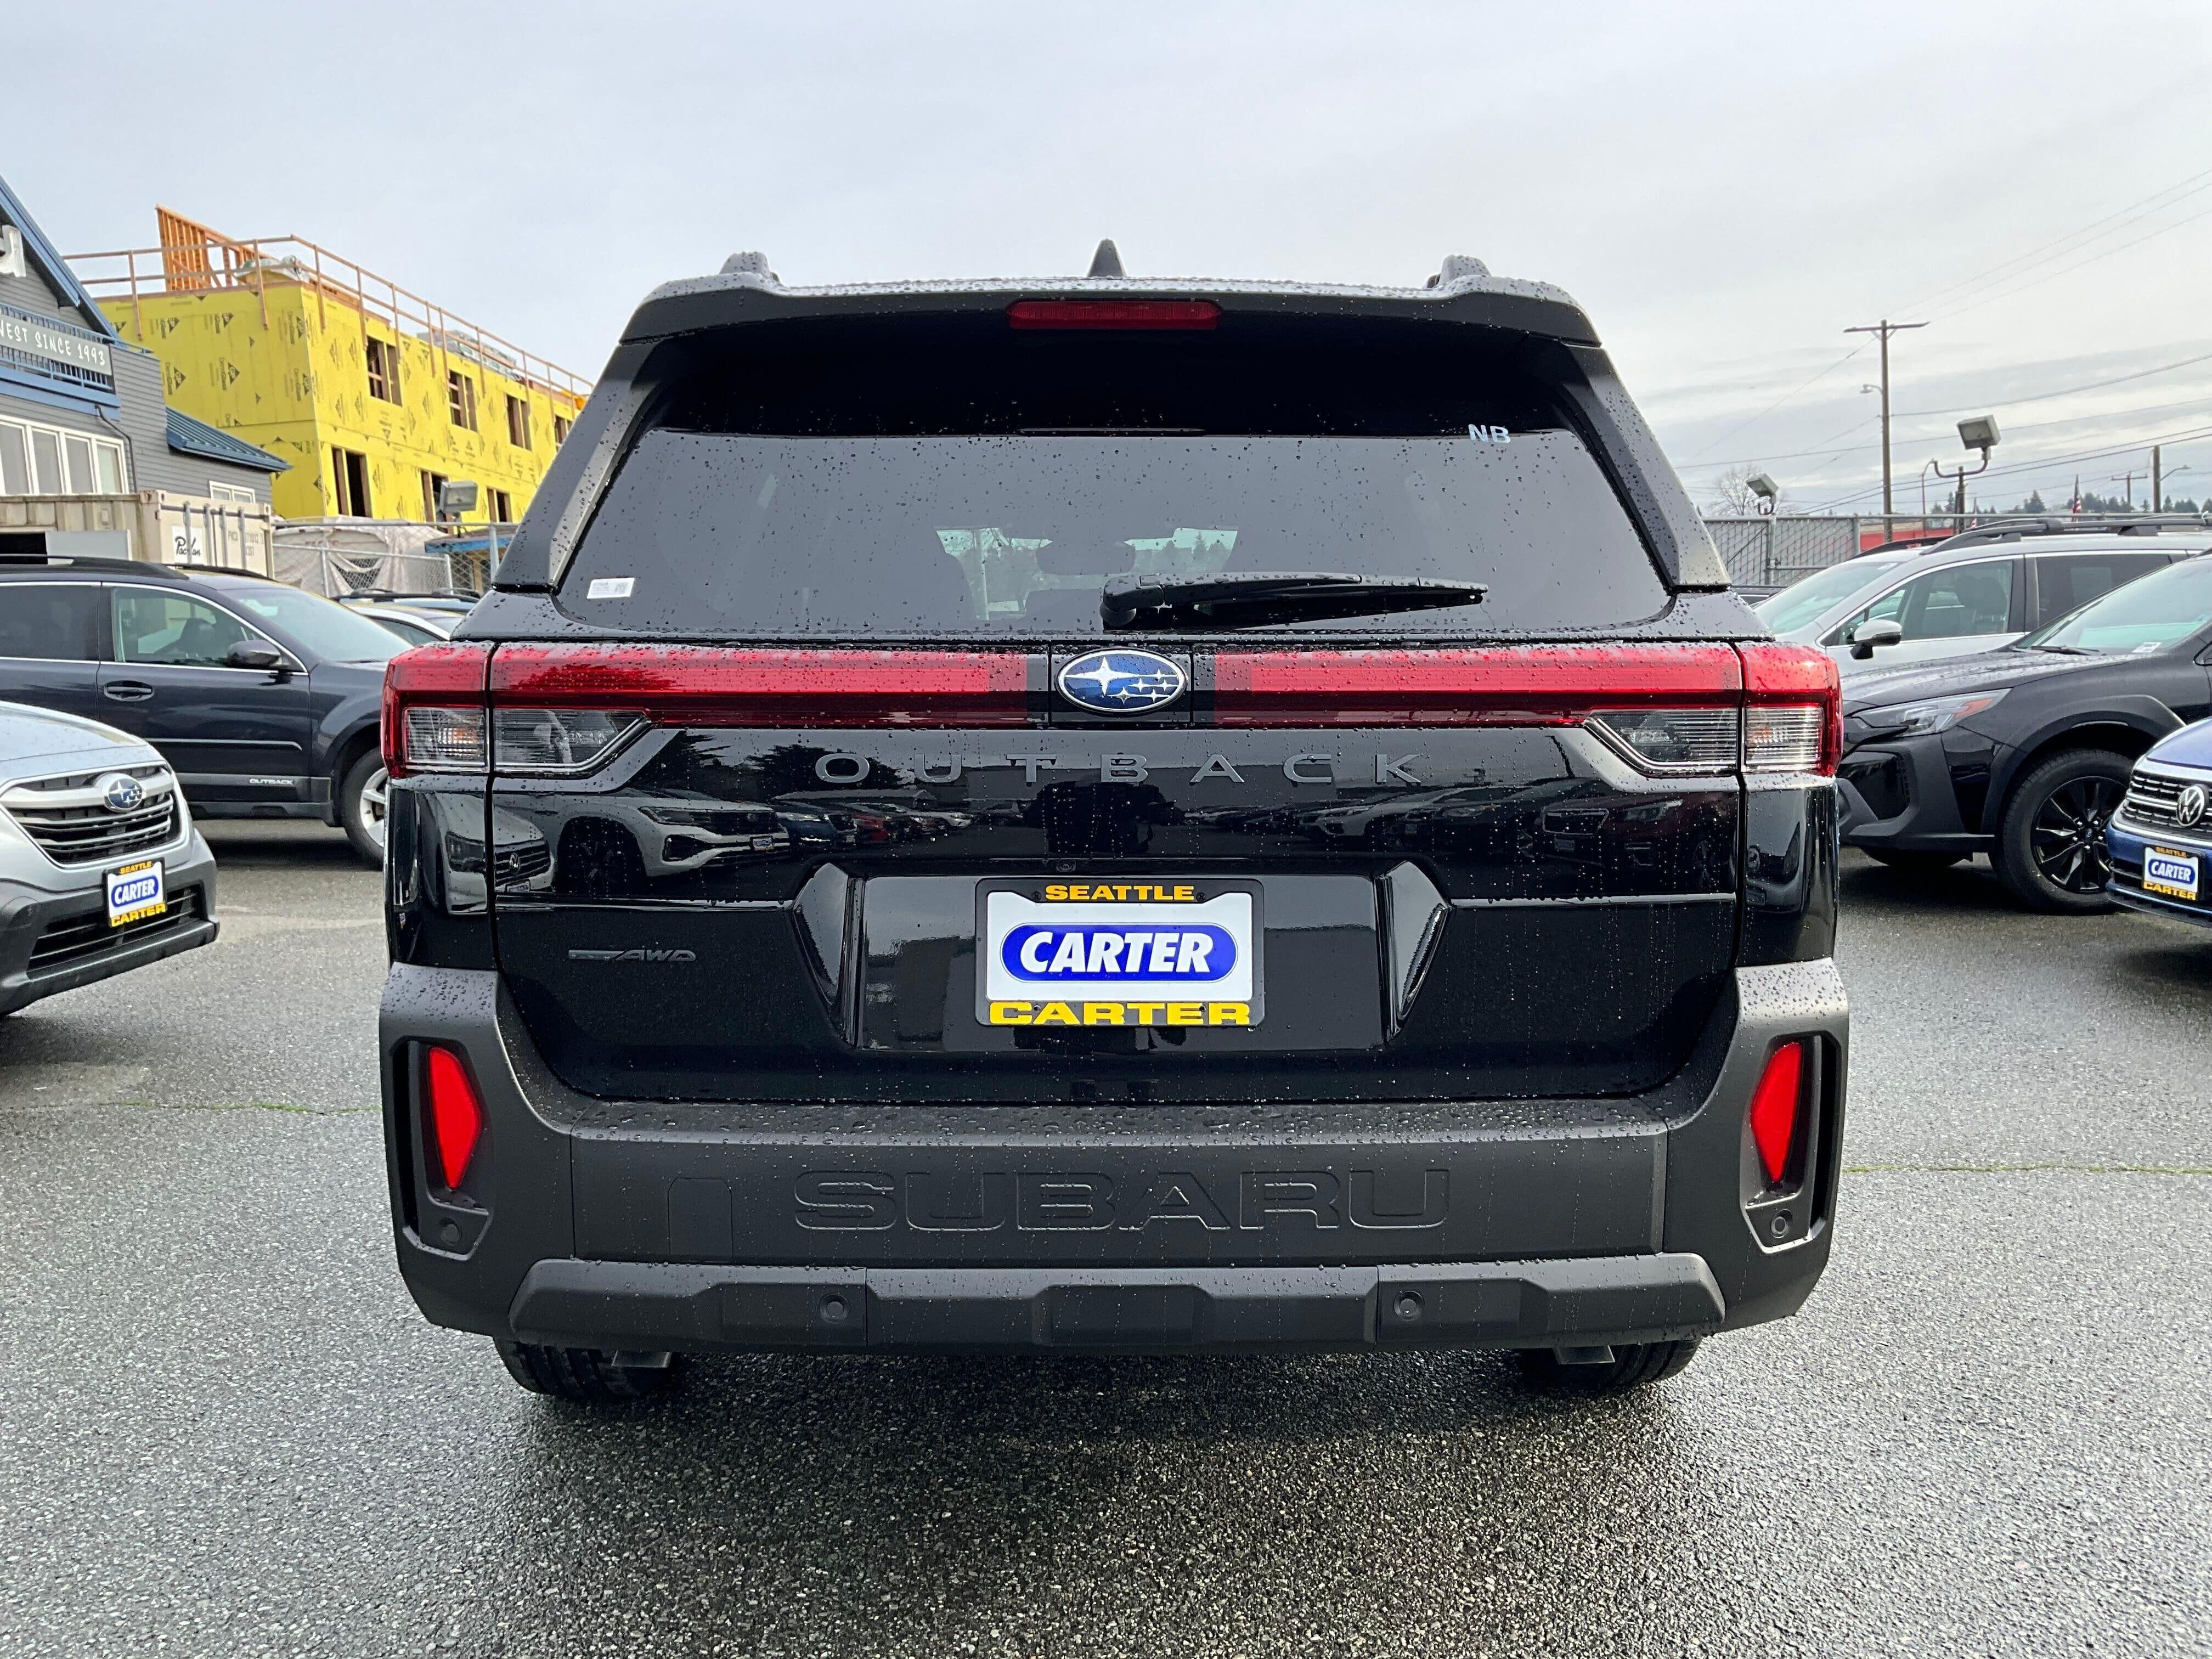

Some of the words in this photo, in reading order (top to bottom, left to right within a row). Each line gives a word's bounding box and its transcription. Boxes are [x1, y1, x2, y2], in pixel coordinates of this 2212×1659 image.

[35, 331, 71, 357] SINCE
[77, 342, 106, 366] 1993
[1468, 424, 1510, 443] NB
[815, 752, 1421, 784] OUTBACK
[2155, 846, 2187, 858] SEATTLE
[120, 861, 152, 874] SEATTLE
[2151, 861, 2191, 882] CARTER
[114, 879, 155, 904] CARTER
[1045, 884, 1195, 901] SEATTLE
[2143, 882, 2196, 900] CARTER
[111, 903, 166, 927] CARTER
[614, 950, 696, 961] AWD
[1019, 930, 1214, 974] CARTER
[989, 1001, 1251, 1026] CARTER
[794, 1169, 1449, 1231] SUBARU
